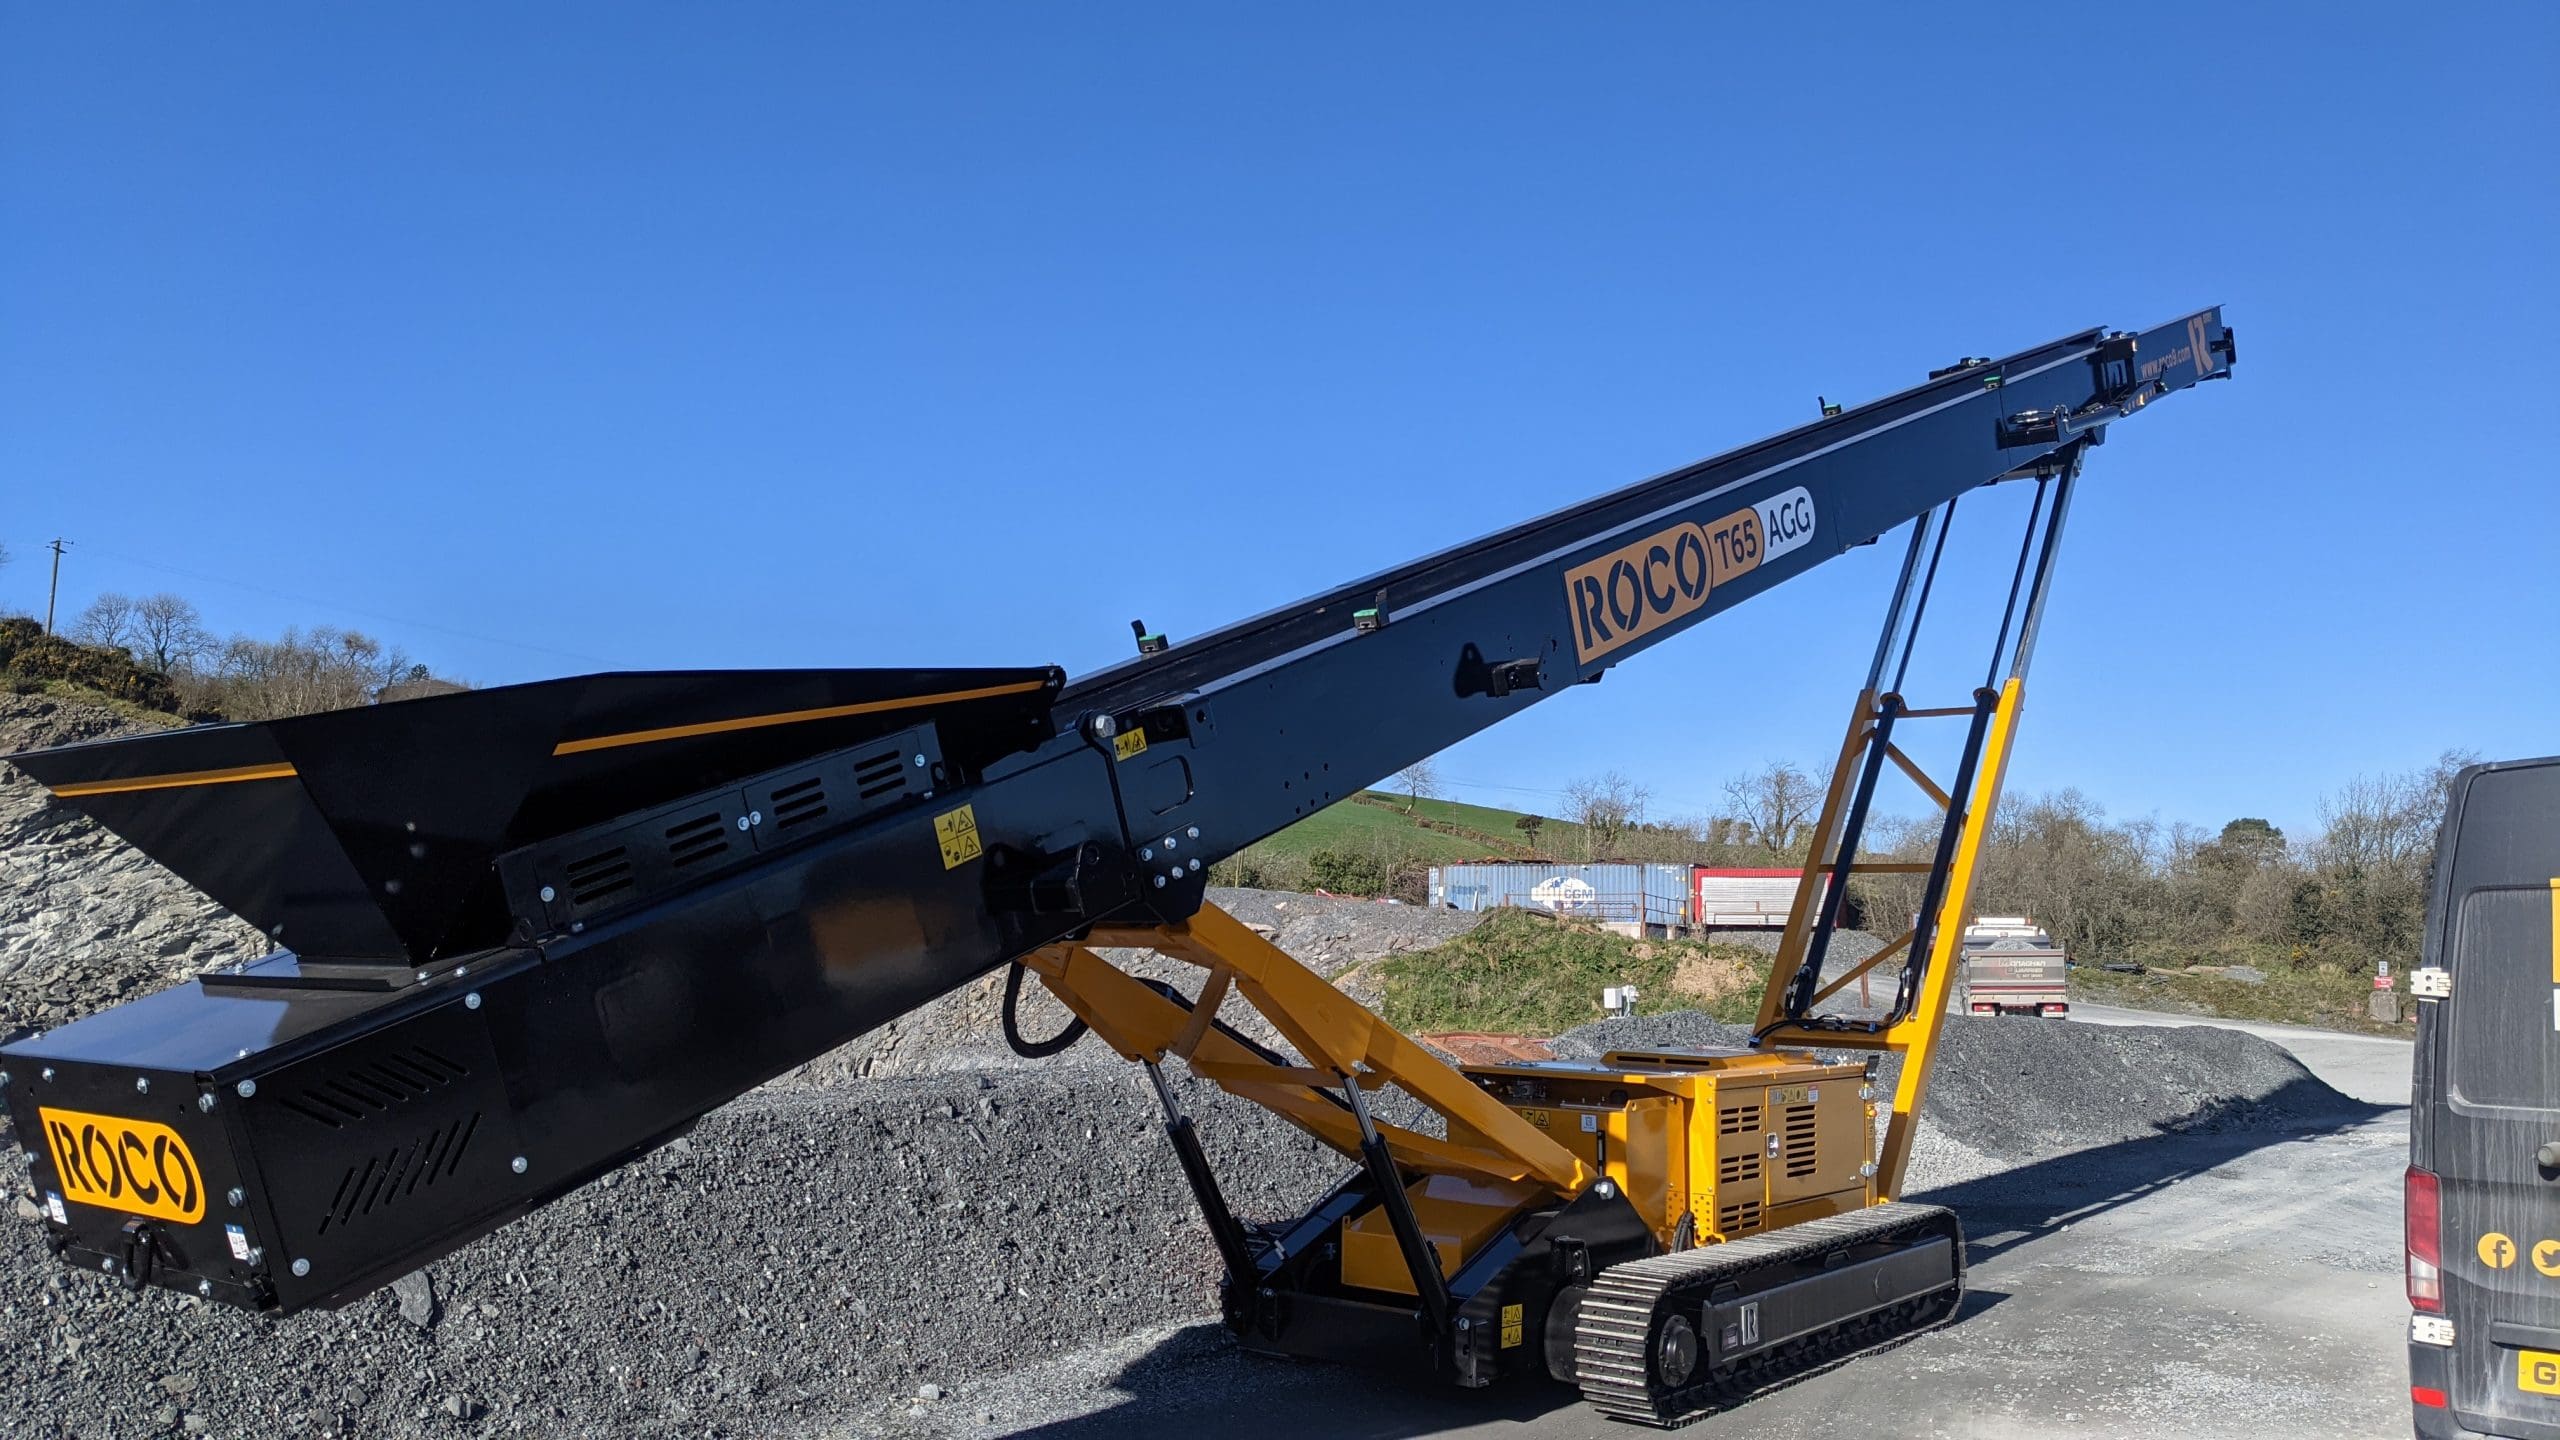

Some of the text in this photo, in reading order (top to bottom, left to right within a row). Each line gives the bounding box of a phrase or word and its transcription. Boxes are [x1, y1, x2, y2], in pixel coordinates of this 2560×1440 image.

[1573, 497, 1811, 651] ROCO T65 AGG
[1564, 889, 1593, 899] CGM
[49, 1120, 197, 1214] ROCO
